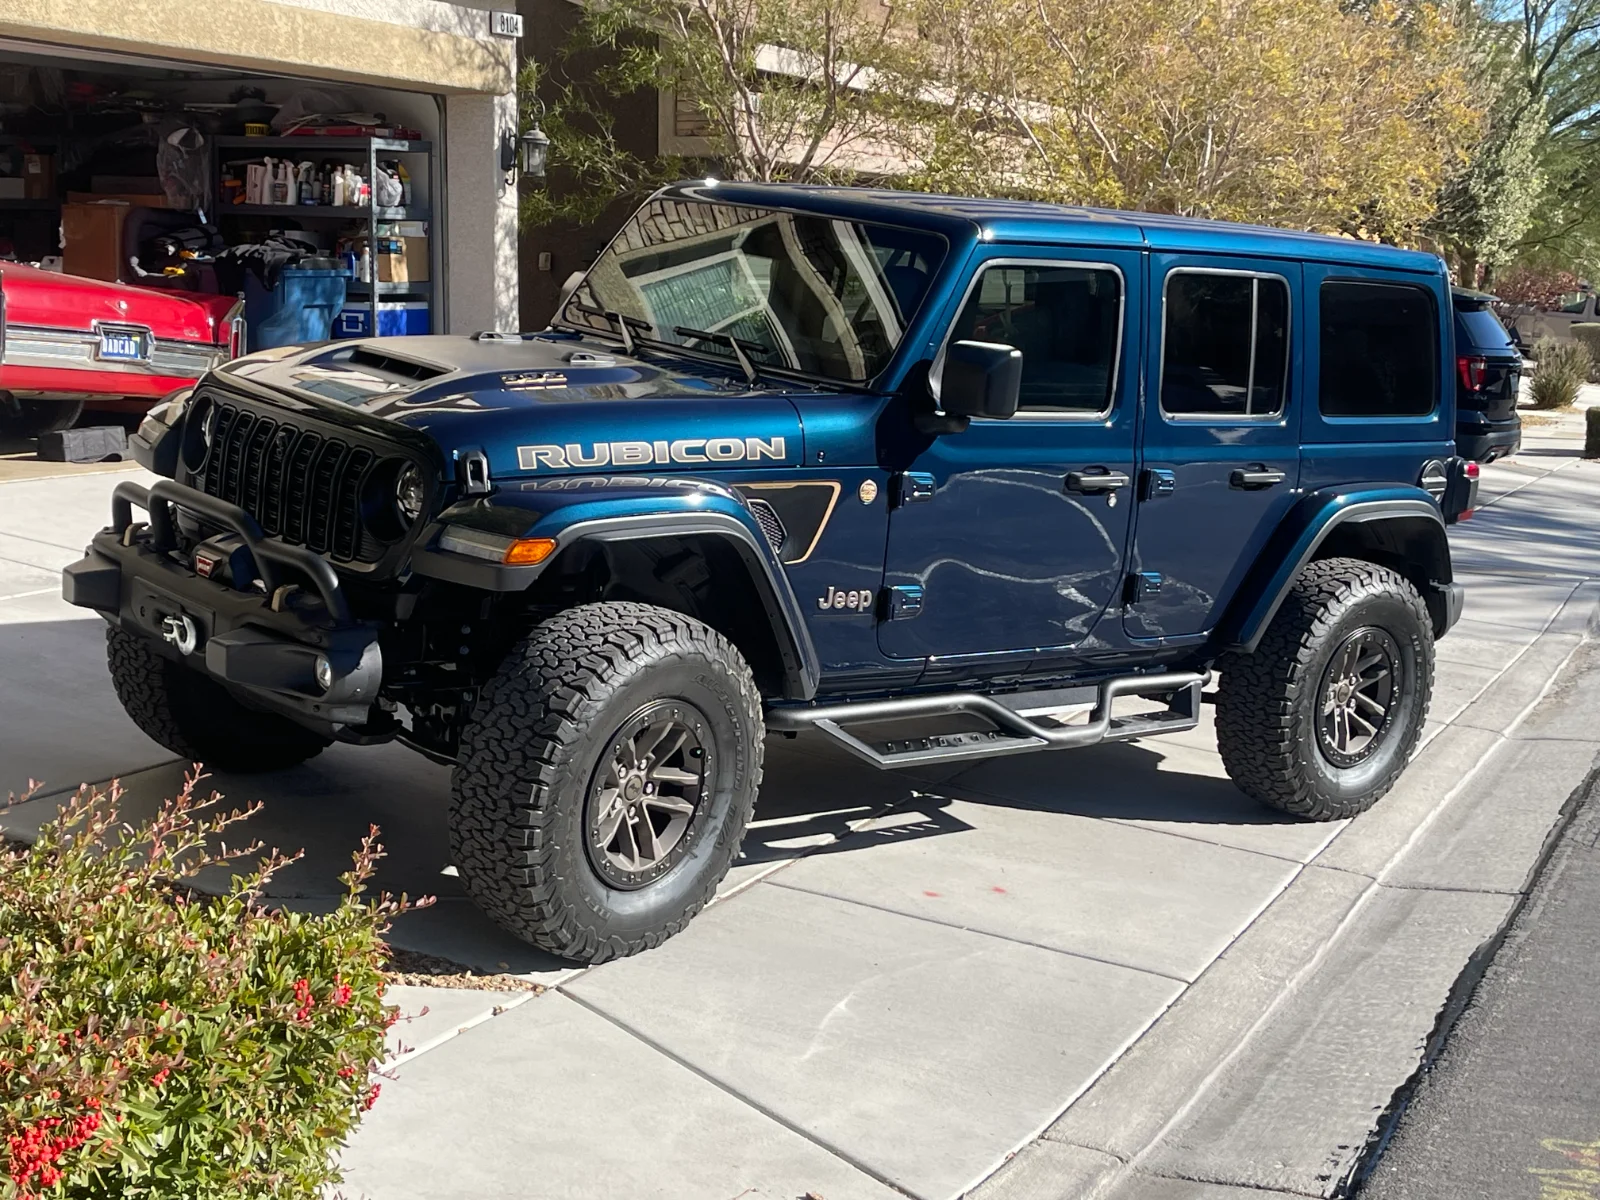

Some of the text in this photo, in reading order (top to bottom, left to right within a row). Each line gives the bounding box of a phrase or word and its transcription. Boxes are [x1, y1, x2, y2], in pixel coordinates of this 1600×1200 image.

[500, 14, 519, 34] 8104
[517, 437, 785, 470] RUBICON
[818, 586, 873, 612] Jeep
